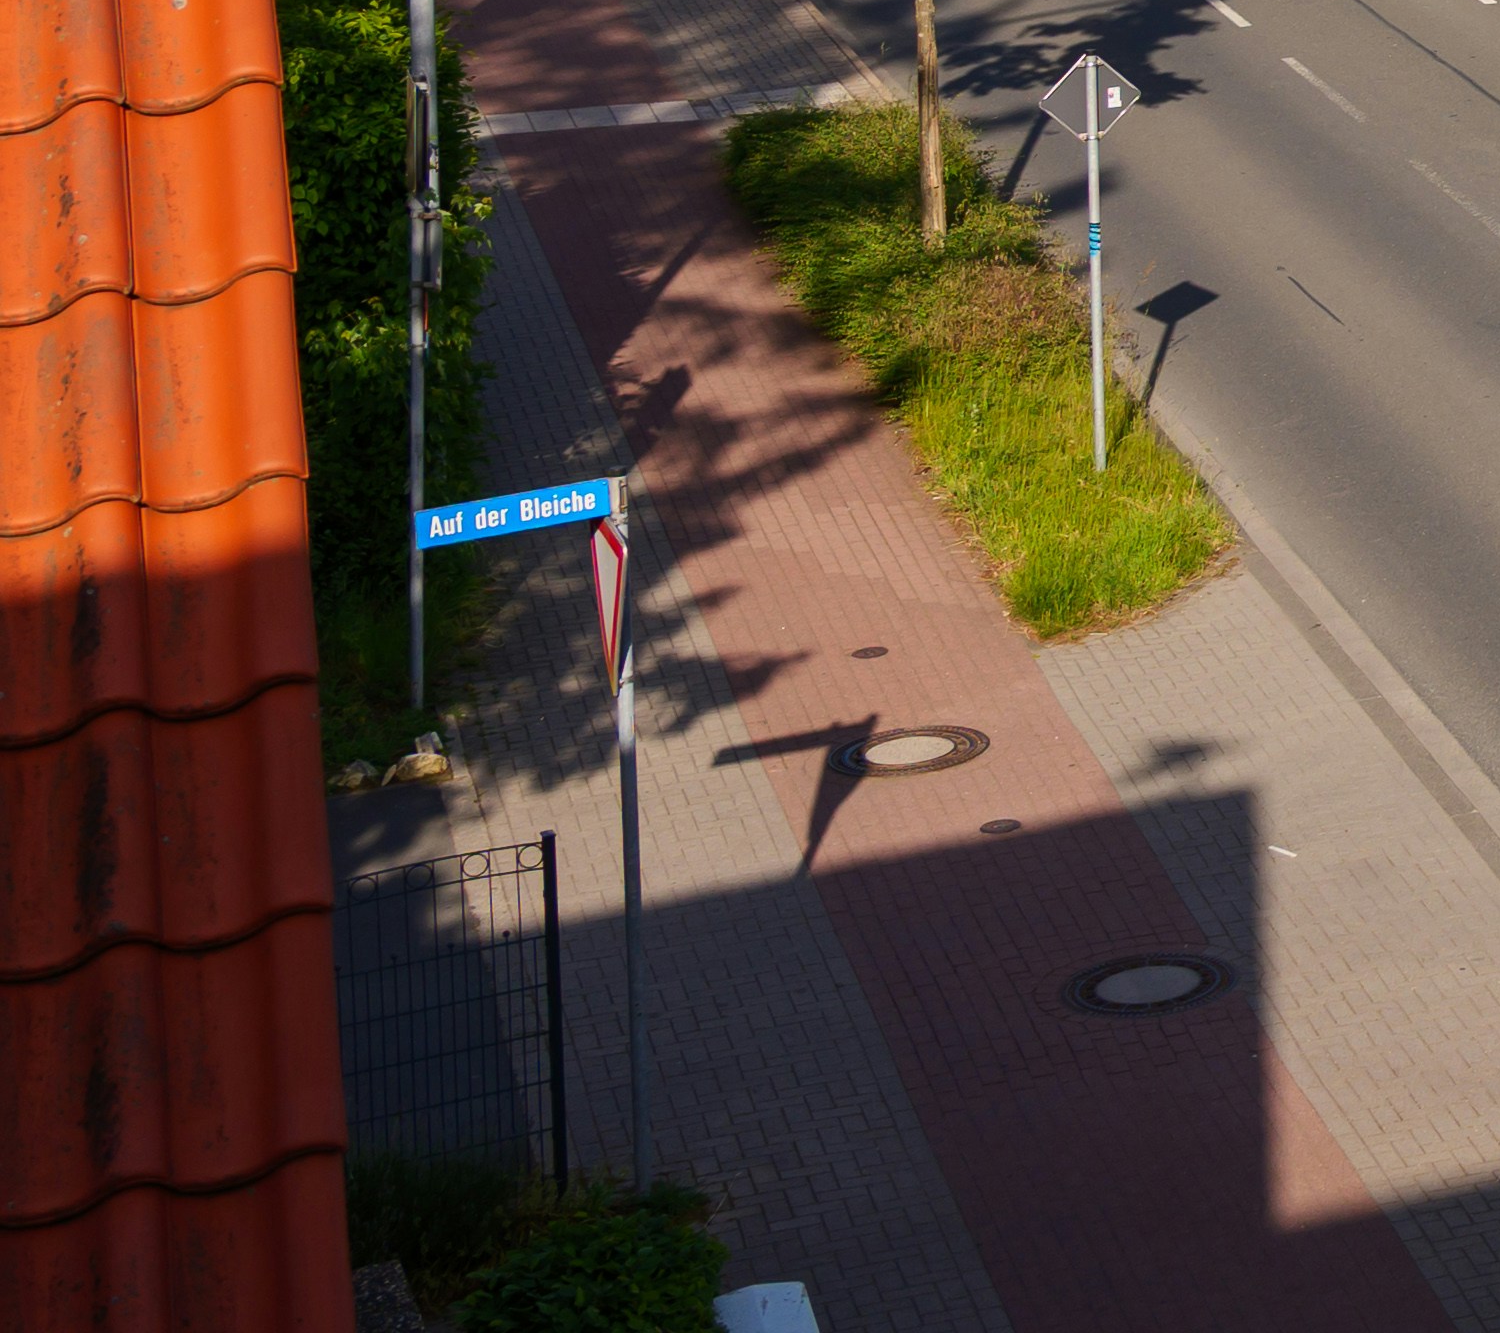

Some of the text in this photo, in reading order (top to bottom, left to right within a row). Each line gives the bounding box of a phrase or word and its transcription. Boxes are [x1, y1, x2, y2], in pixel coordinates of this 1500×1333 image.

[430, 491, 596, 538] Auf der Bleiche
